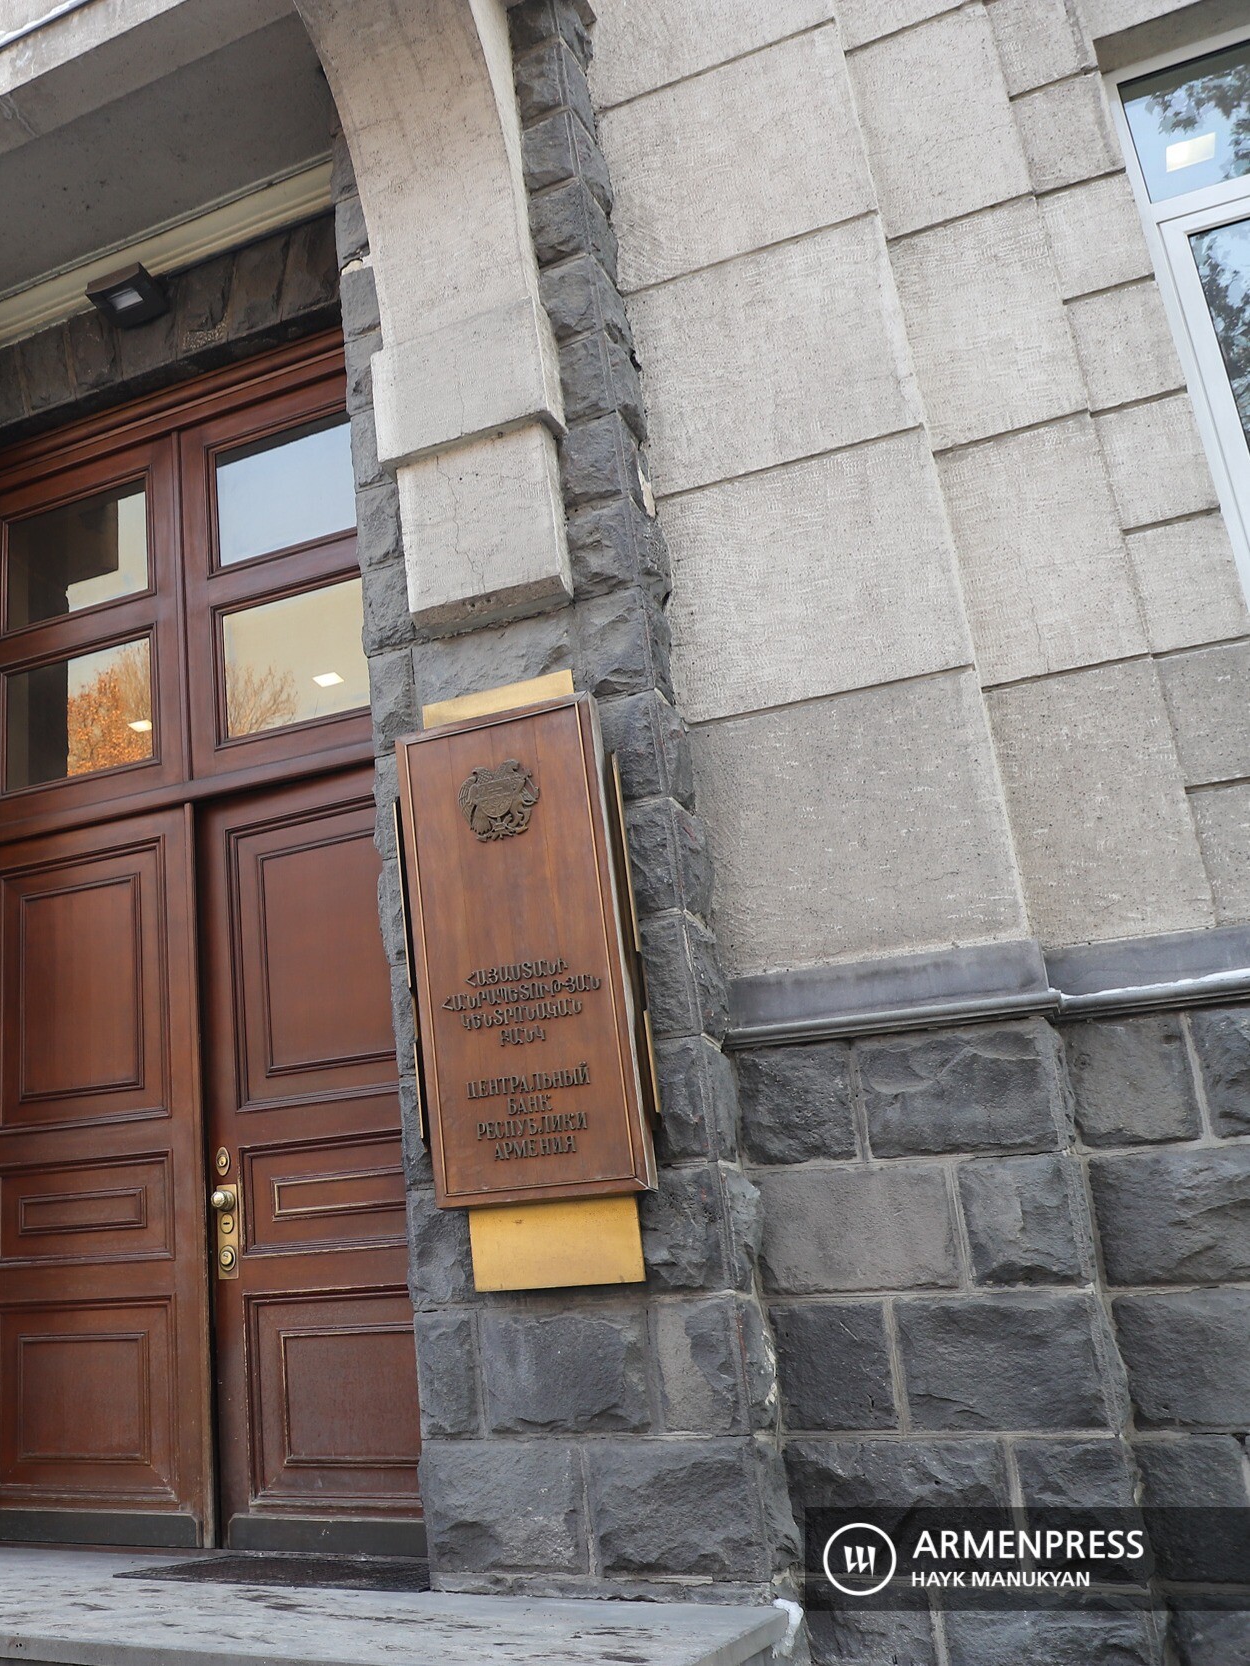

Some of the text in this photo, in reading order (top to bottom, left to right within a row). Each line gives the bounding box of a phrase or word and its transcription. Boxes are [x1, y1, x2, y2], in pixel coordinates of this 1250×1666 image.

[463, 957, 569, 988] ՀԱՅԱՍՏԱՆԻ
[441, 973, 602, 1012] ՀԱՆՐԱՊԵՏՈՒԹՅԱՆ
[460, 998, 583, 1030] ԿԵՆՏՐՈՆԱԿԱՆ
[500, 1023, 546, 1047] ԲԱՆԿ
[466, 1061, 591, 1100] ЦЕНТРАЛЬНЫЙ
[507, 1094, 553, 1116] БАНК
[476, 1111, 588, 1141] РЕСПУБЛИКИ
[494, 1135, 576, 1161] АРМЕНИЯ
